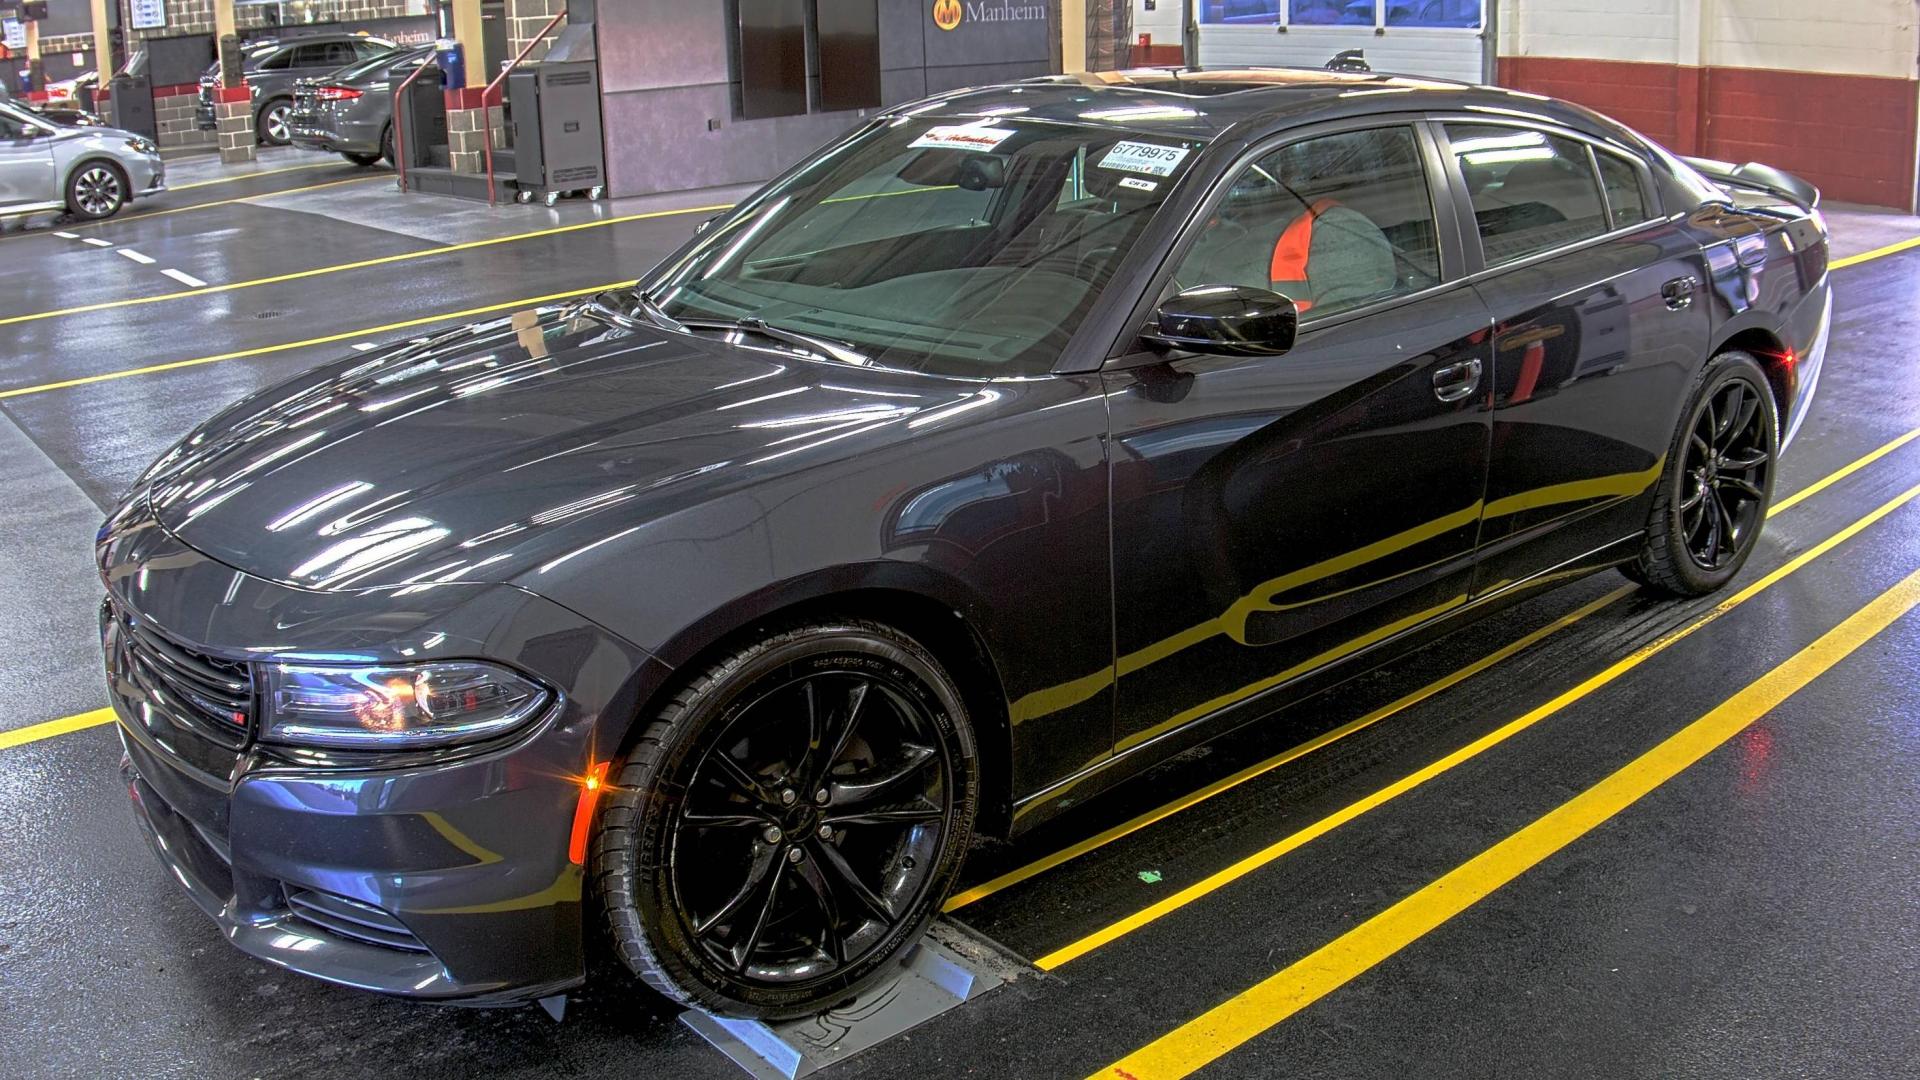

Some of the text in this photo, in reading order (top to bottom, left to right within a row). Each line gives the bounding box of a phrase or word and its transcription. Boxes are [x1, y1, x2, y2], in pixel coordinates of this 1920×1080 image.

[966, 0, 1046, 22] Manheim
[374, 30, 429, 44] nheim
[1112, 143, 1179, 161] 6779975
